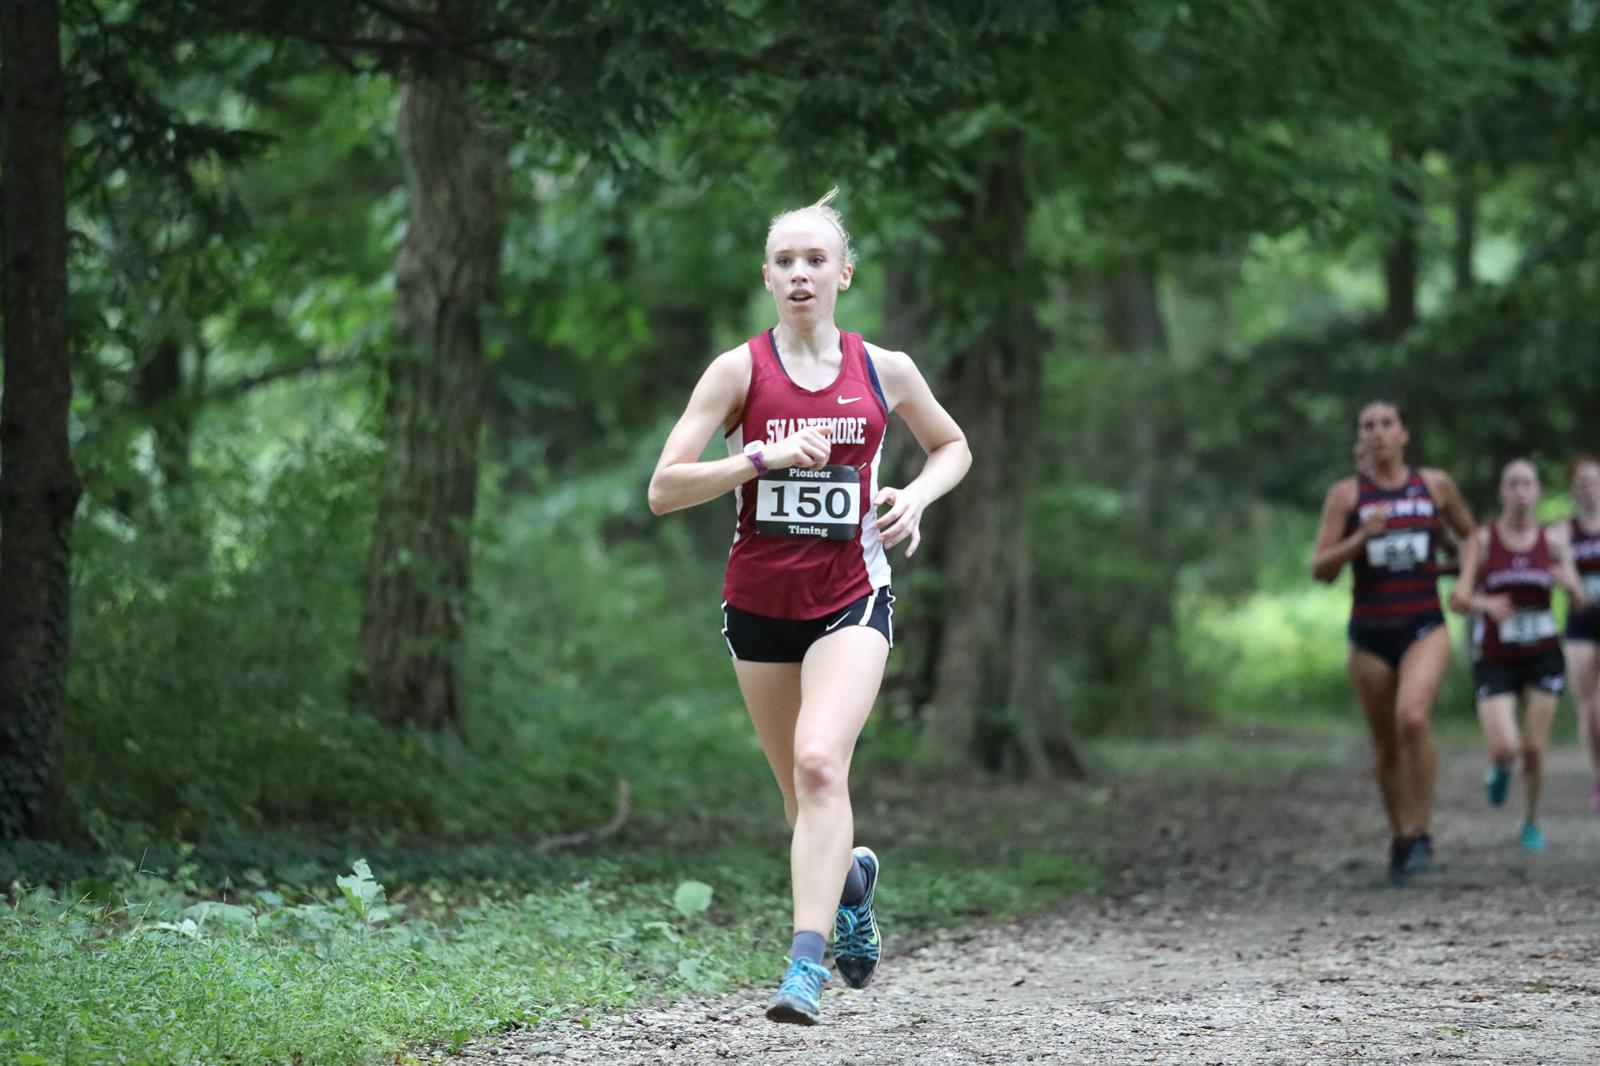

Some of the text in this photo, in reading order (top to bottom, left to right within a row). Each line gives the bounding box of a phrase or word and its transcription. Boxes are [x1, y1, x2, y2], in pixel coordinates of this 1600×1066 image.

[789, 468, 831, 479] Pioneer
[770, 485, 851, 519] 150
[788, 525, 828, 537] Timing
